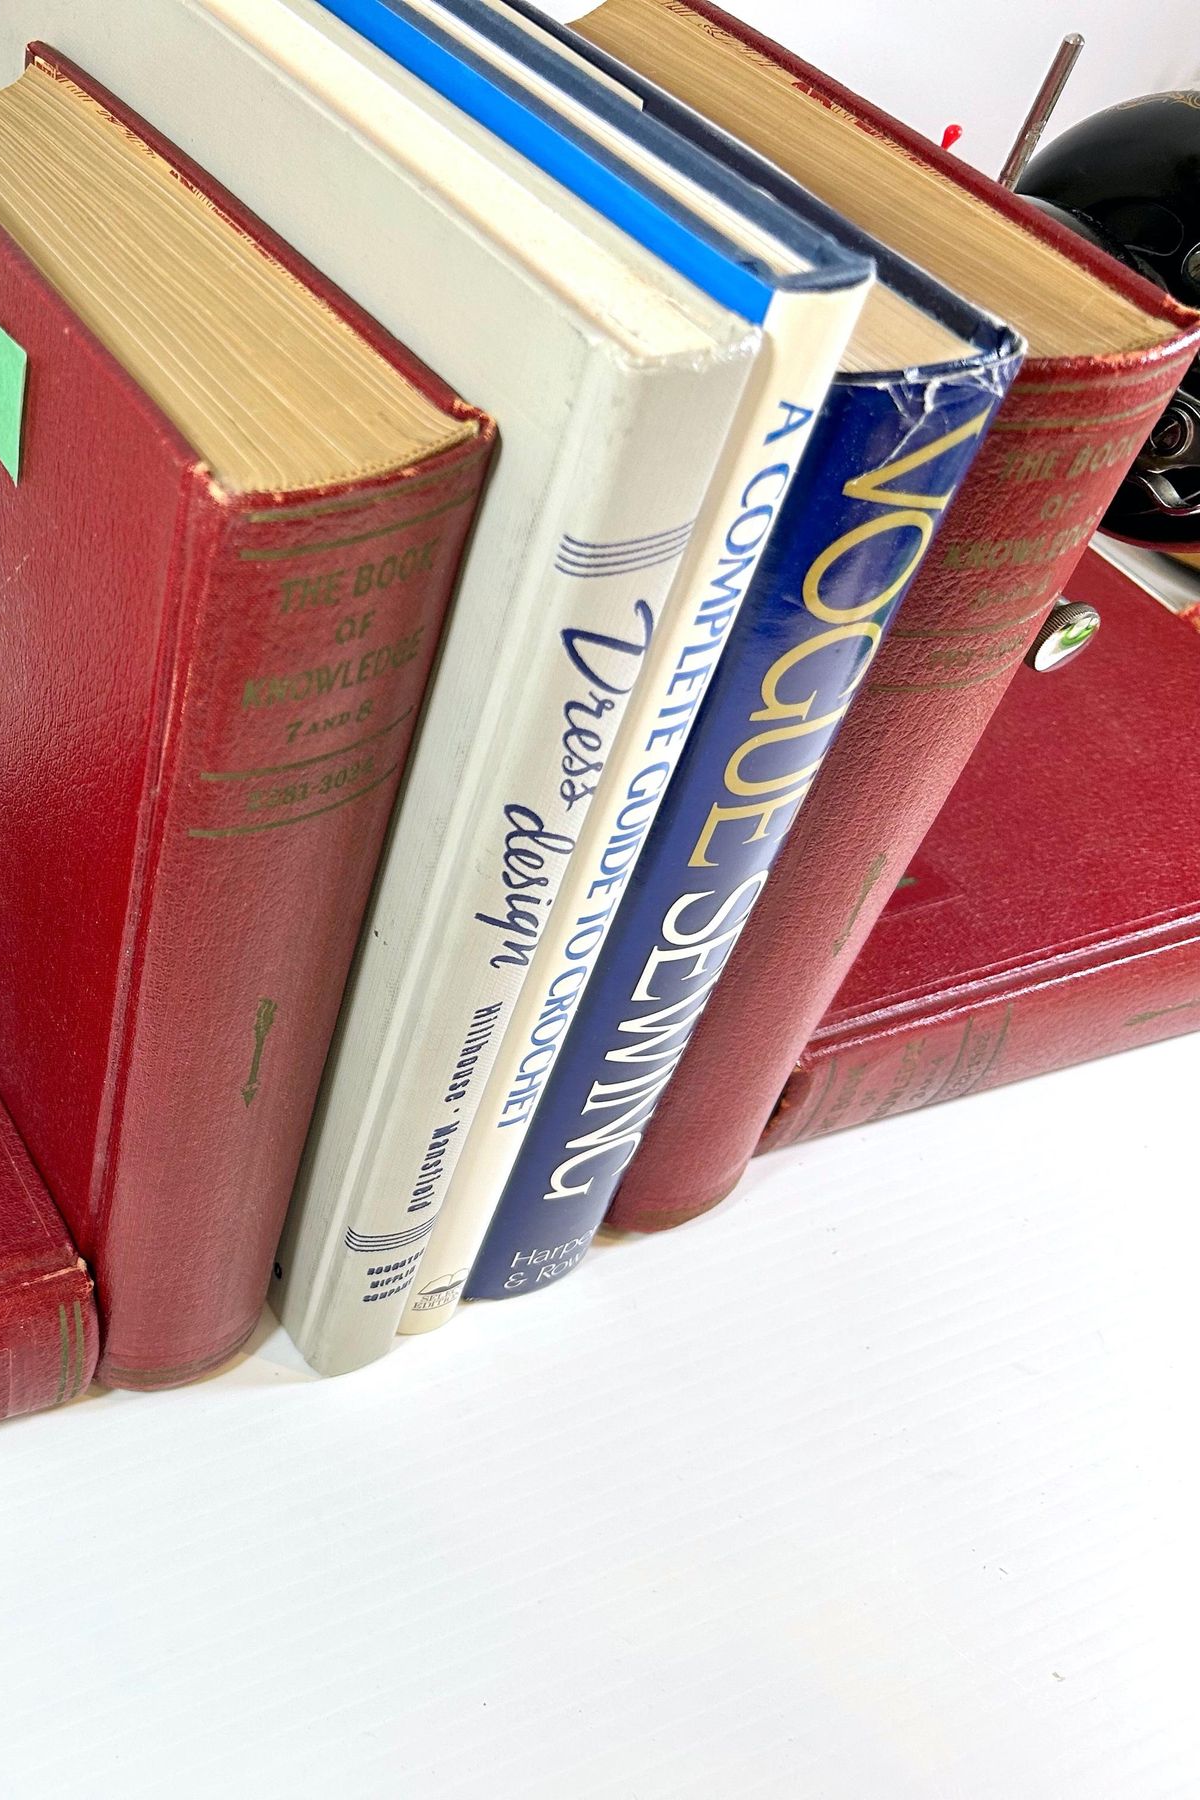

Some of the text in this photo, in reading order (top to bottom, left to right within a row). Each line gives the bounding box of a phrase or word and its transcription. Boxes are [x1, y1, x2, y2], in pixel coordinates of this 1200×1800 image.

[279, 536, 442, 615] THE BOOK
[334, 610, 377, 645] OF
[242, 625, 426, 711] KNOWLEDGE
[285, 720, 304, 744] 7
[356, 699, 374, 723] 8
[474, 600, 654, 969] Dress design
[497, 399, 815, 1129] A COMPLETE GUIDE TO CROCHET
[542, 408, 992, 1200] VOGUE SEWING
[407, 1001, 503, 1213] Hillhouse Mansfield
